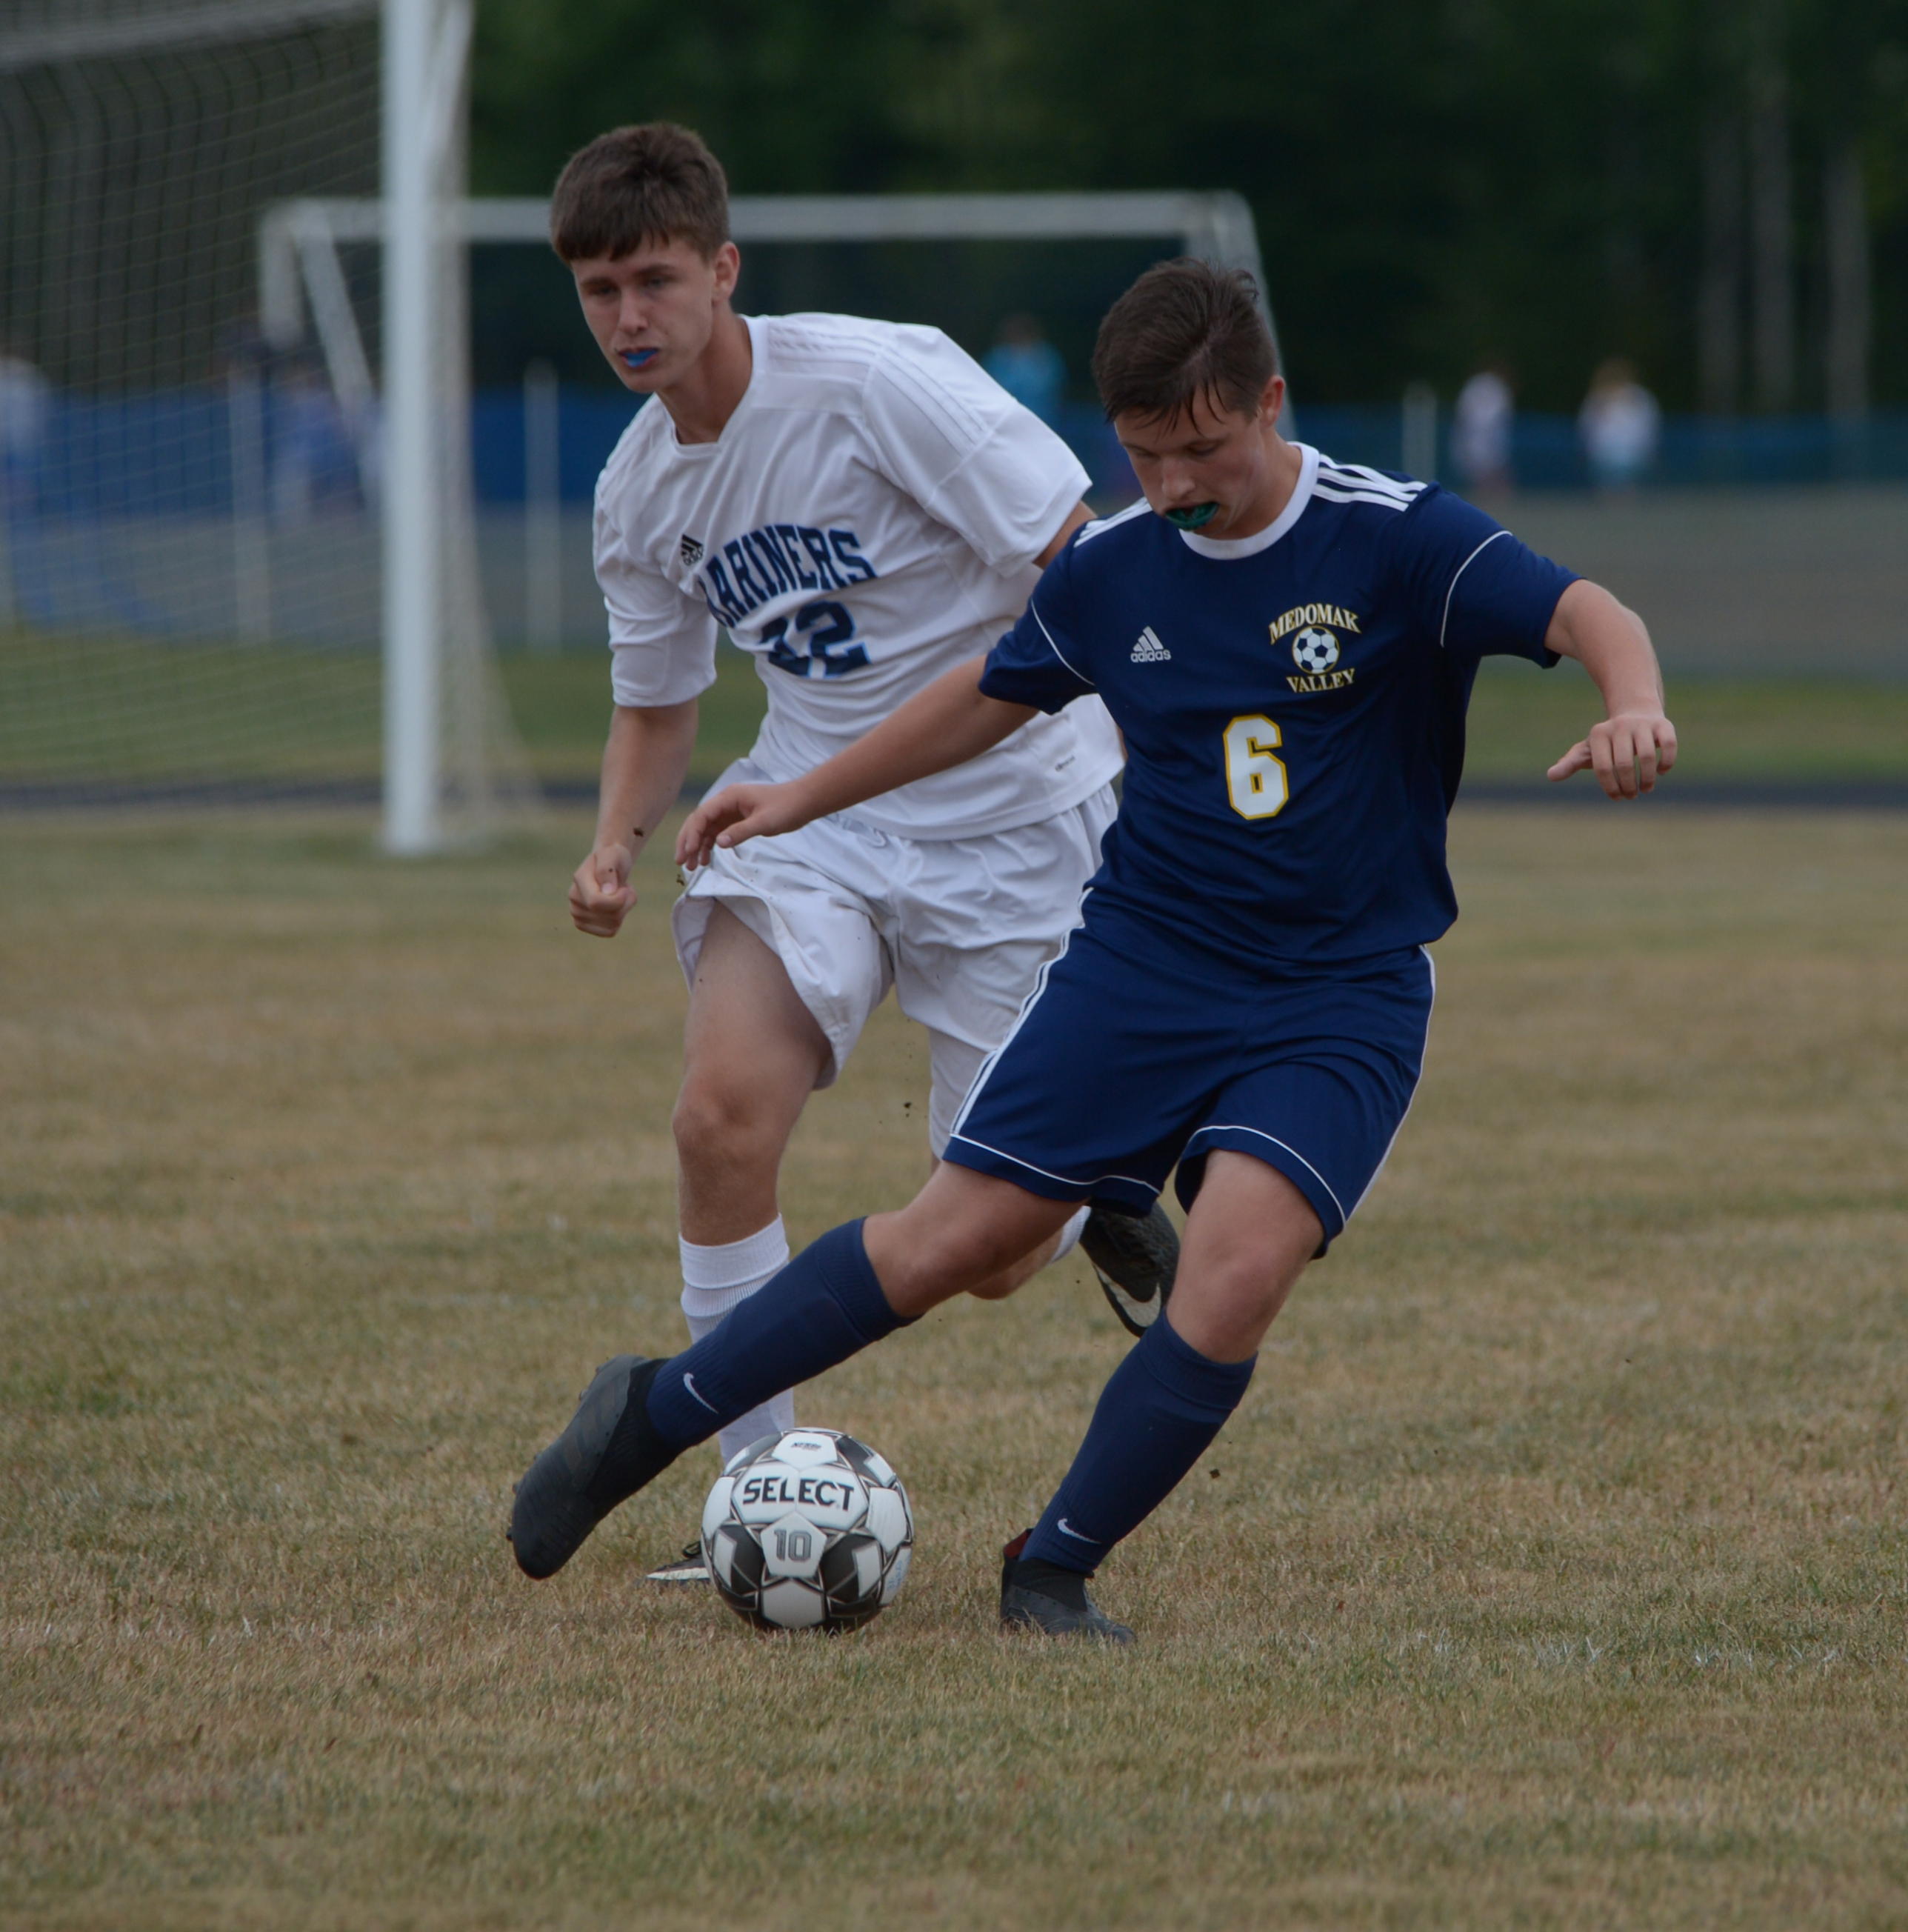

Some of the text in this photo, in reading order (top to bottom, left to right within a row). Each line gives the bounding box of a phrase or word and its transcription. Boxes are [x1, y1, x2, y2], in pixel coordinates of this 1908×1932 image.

[1269, 603, 1361, 645] MEDOMAK
[1130, 649, 1171, 663] adidas
[1286, 667, 1355, 693] VALLEY
[1223, 713, 1289, 820] 6
[743, 1476, 854, 1511] SELECT
[773, 1529, 812, 1562] 10
